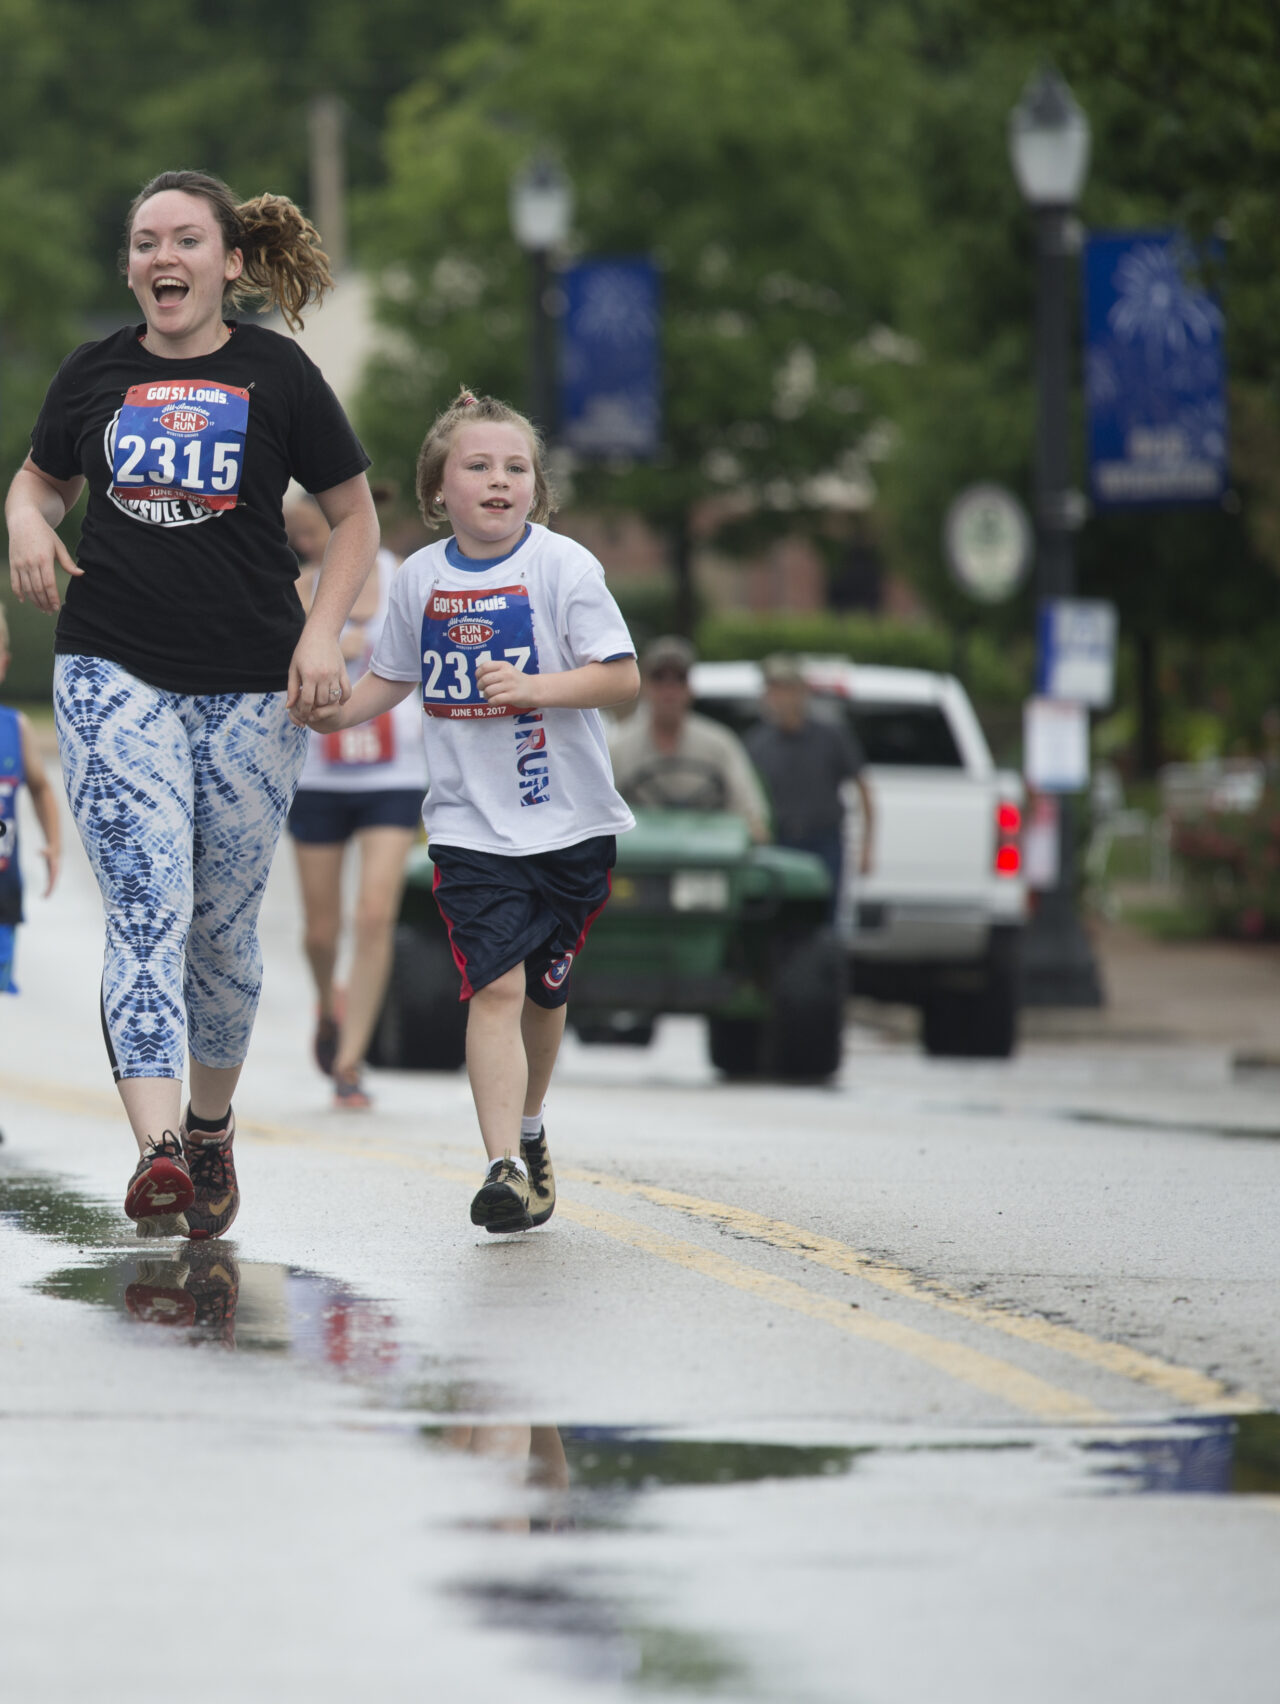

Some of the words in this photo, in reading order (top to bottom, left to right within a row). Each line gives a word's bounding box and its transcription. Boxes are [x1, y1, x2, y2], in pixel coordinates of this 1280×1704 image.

[188, 387, 228, 404] Louis
[174, 412, 197, 422] FUN
[173, 421, 196, 431] RUN
[117, 435, 241, 491] 2315
[149, 488, 173, 497] JUNE
[467, 595, 507, 613] Louis
[448, 615, 494, 627] All-American
[459, 625, 482, 634] FUN
[460, 634, 483, 644] RUN
[451, 708, 472, 717] JUNE
[473, 708, 486, 717] 18,
[487, 706, 507, 716] 2017
